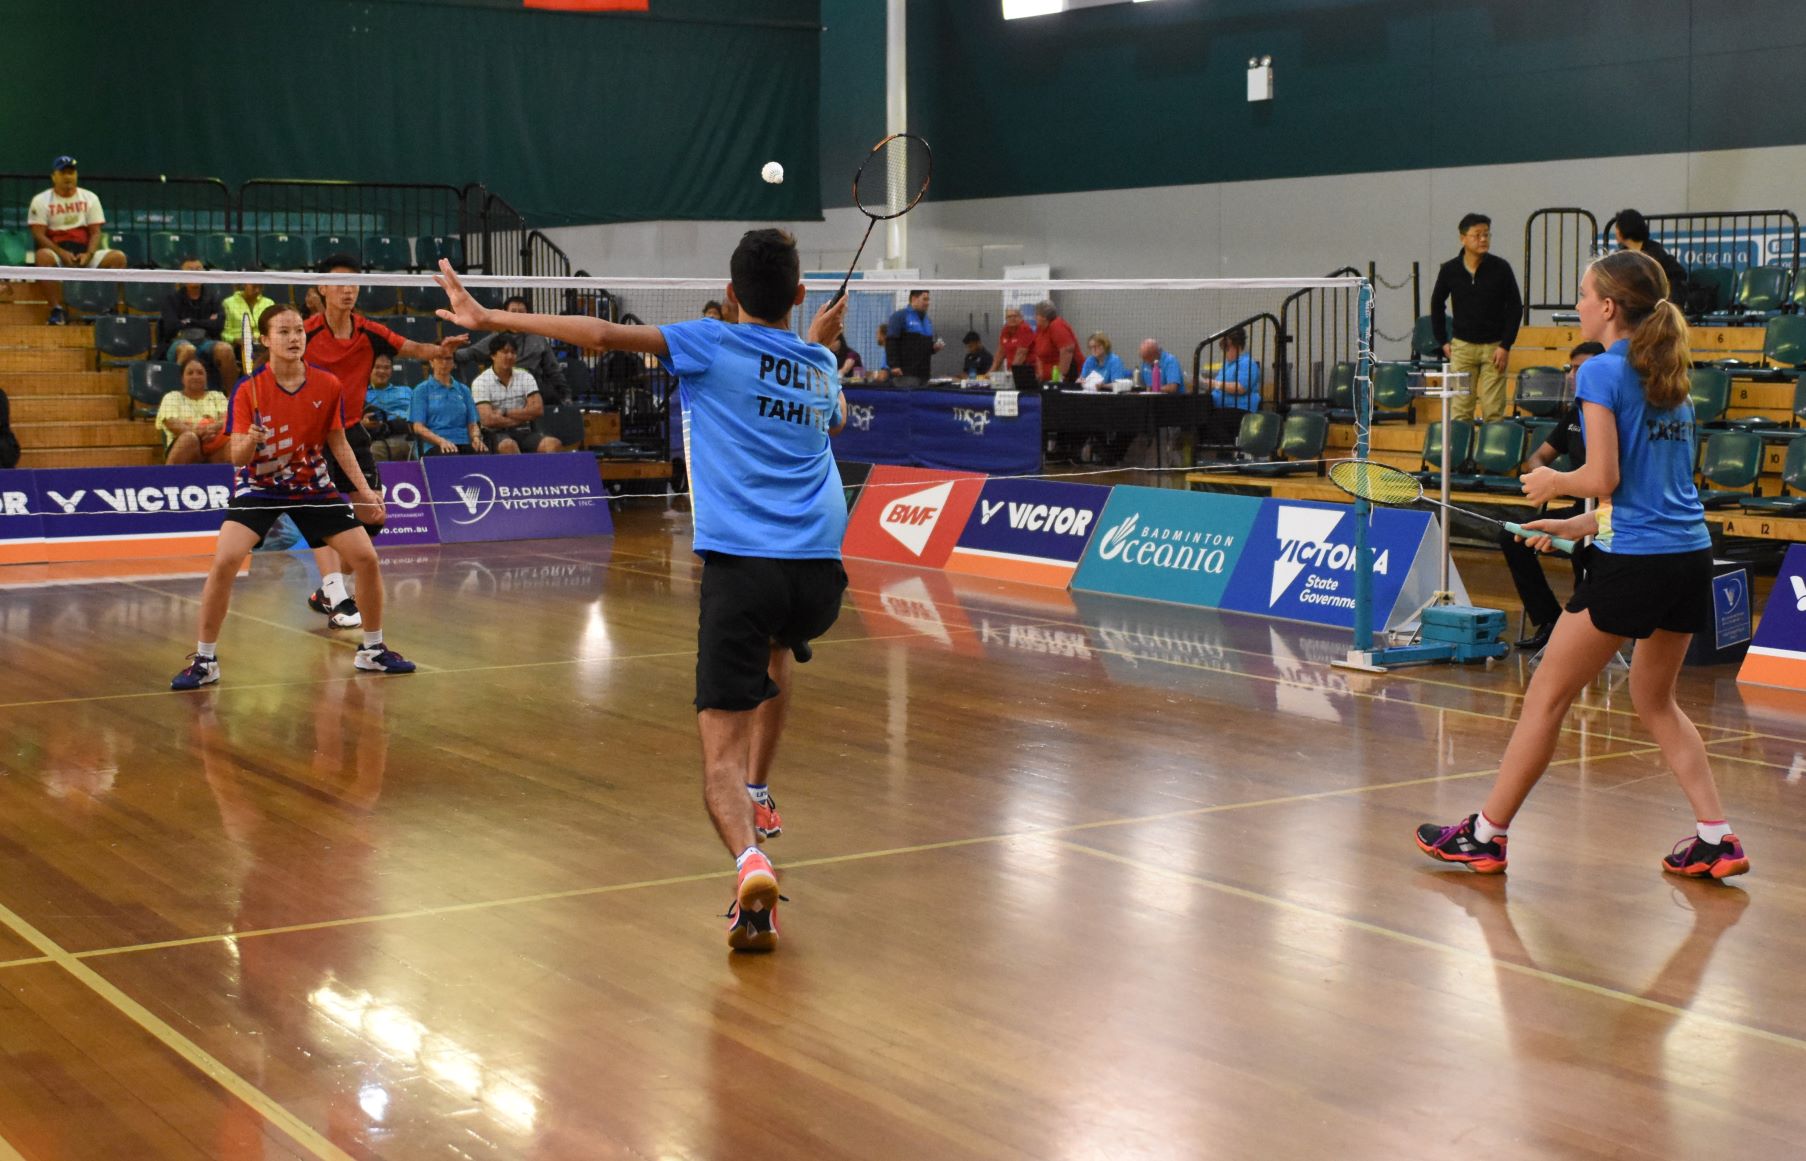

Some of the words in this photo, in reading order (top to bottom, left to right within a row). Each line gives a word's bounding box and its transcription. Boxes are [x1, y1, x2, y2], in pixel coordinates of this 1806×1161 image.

[1717, 333, 1724, 344] 6
[1740, 390, 1749, 400] 8
[1770, 453, 1780, 464] 10
[499, 485, 591, 497] BADMINTON
[93, 485, 231, 512] VICTOR
[501, 498, 576, 510] VICTORIA
[886, 504, 938, 527] BWF
[1008, 502, 1094, 537] VICTOR
[1727, 522, 1735, 532] A
[1761, 524, 1770, 534] 12
[1141, 526, 1235, 547] BADMINTON
[1099, 514, 1226, 574] Oceania
[1305, 574, 1339, 591] State
[1299, 589, 1356, 609] Governme
